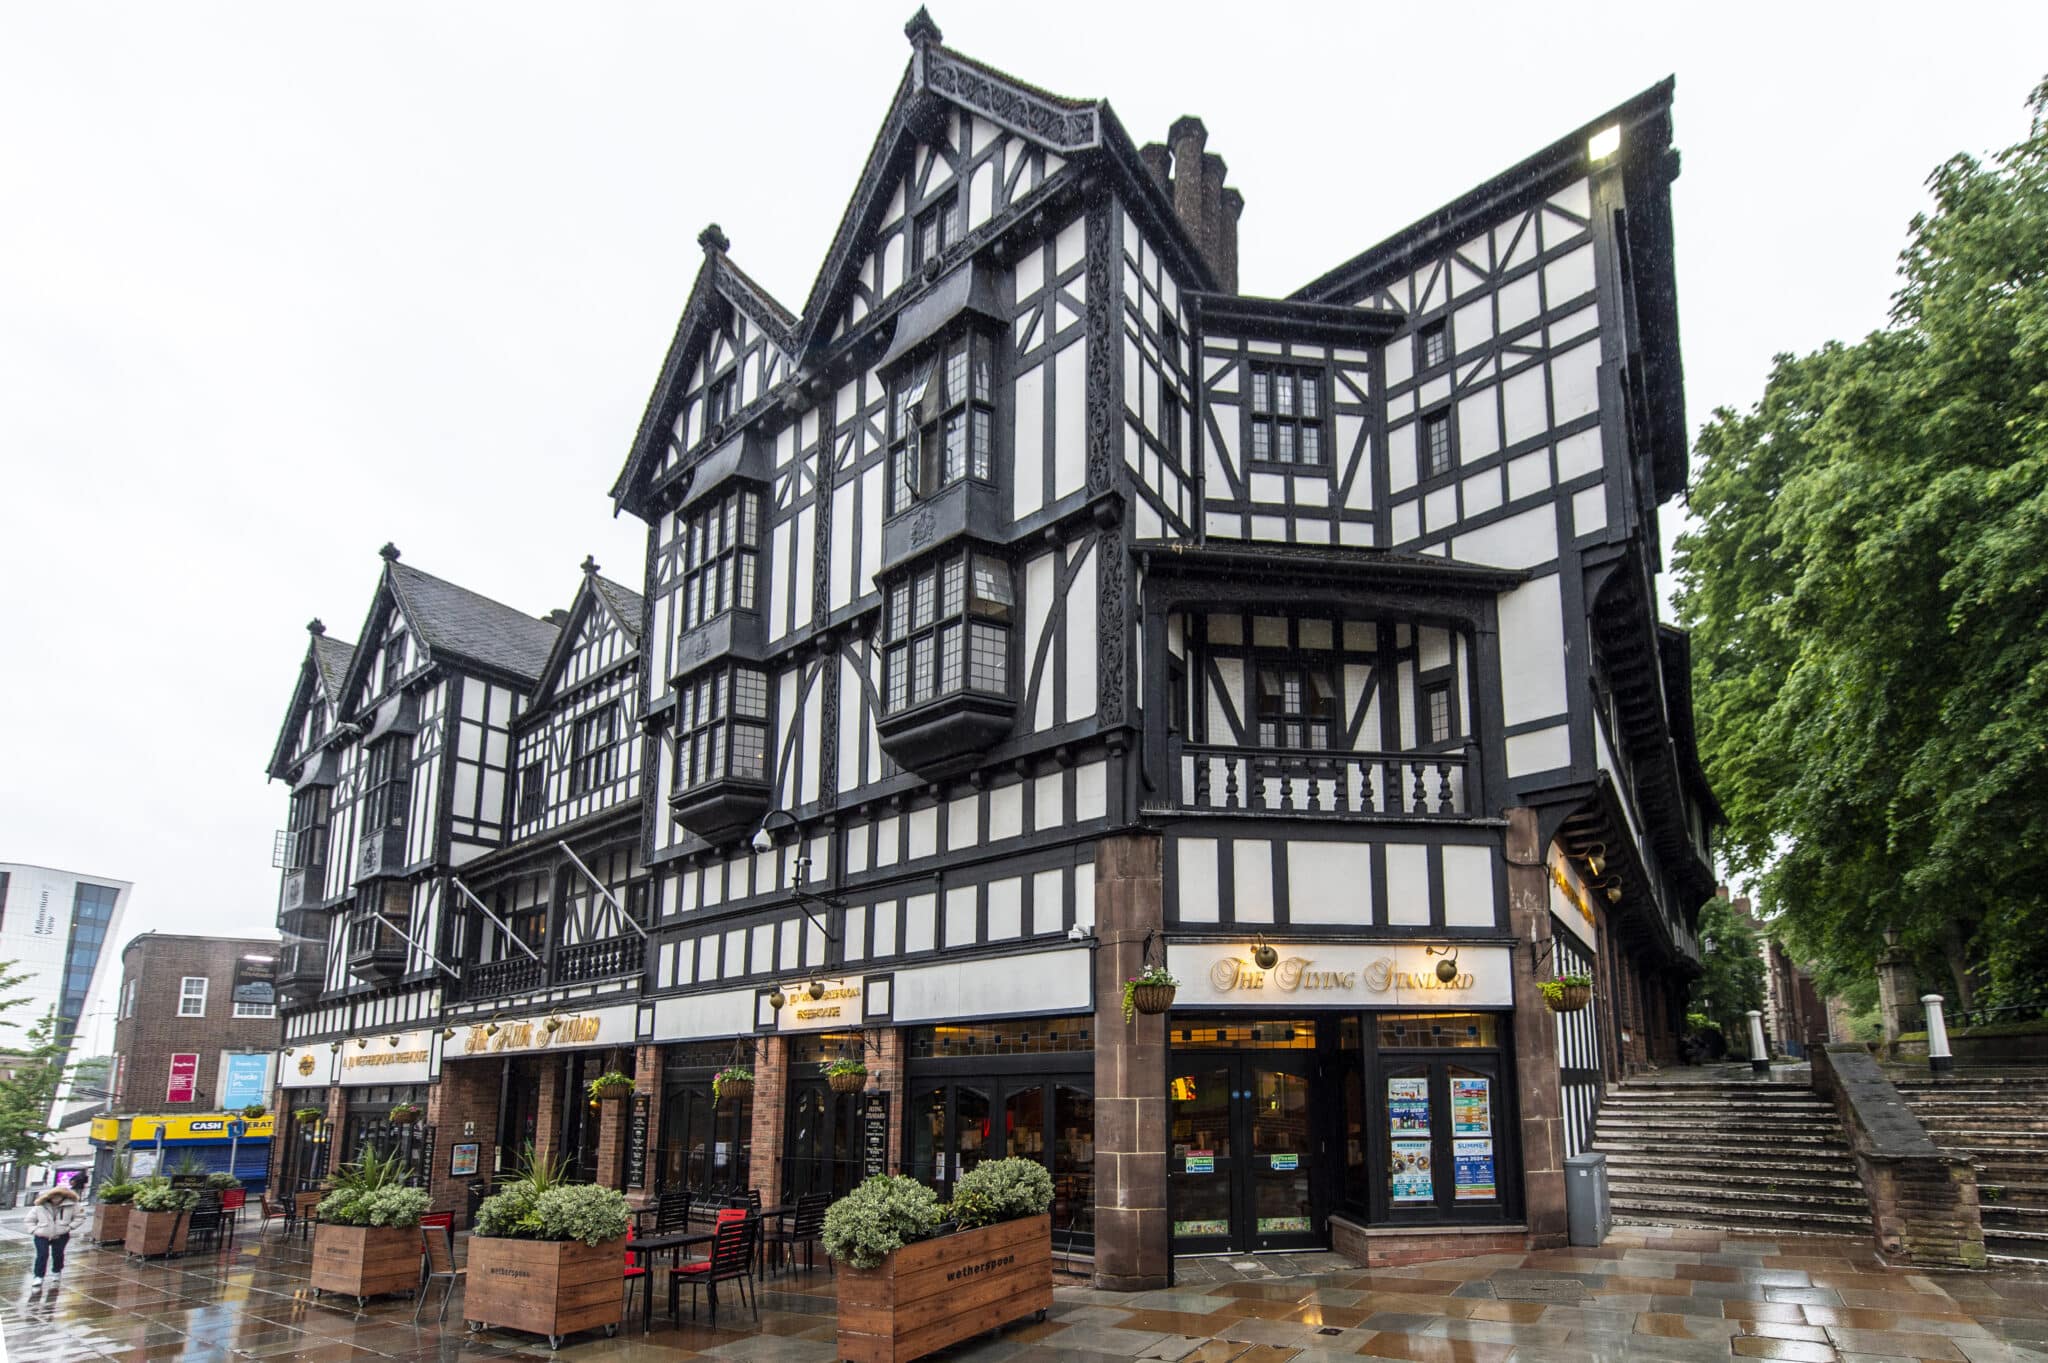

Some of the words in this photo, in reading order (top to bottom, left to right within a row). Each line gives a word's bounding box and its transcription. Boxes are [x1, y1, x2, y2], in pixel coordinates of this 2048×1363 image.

[1210, 957, 1266, 993] THE
[1273, 957, 1356, 993] FLYING
[191, 1122, 222, 1131] CASH
[946, 1255, 1015, 1281] wetherspoon
